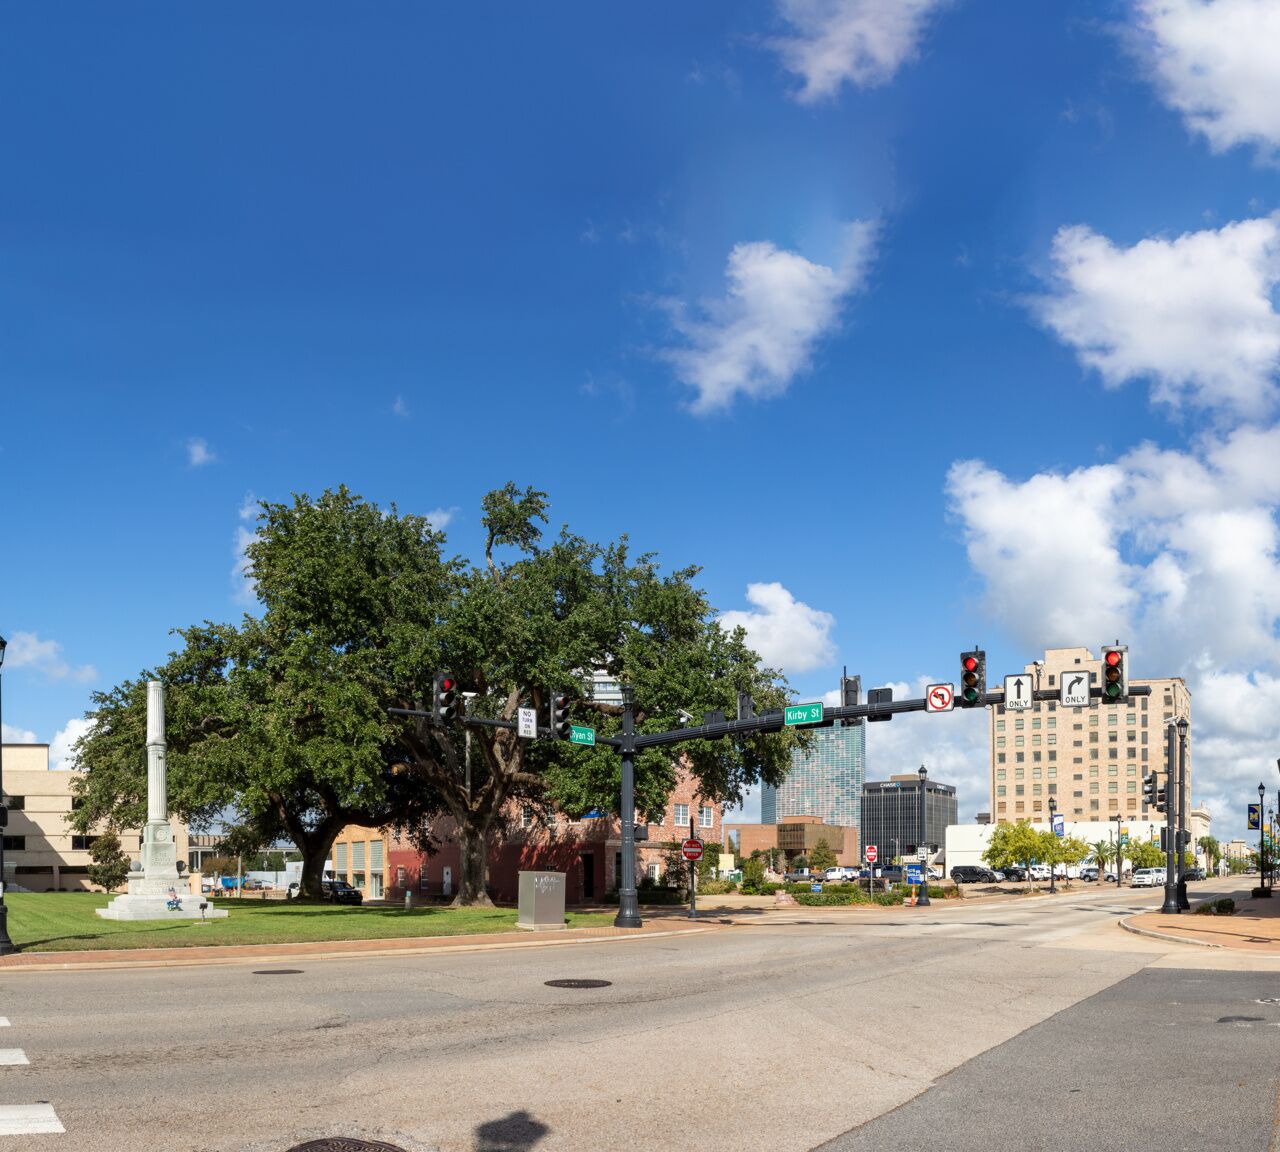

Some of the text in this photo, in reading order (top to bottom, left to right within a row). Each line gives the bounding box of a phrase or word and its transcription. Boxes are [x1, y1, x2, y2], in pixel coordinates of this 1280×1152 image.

[787, 708, 819, 721] Kirby St
[587, 732, 593, 741] St
